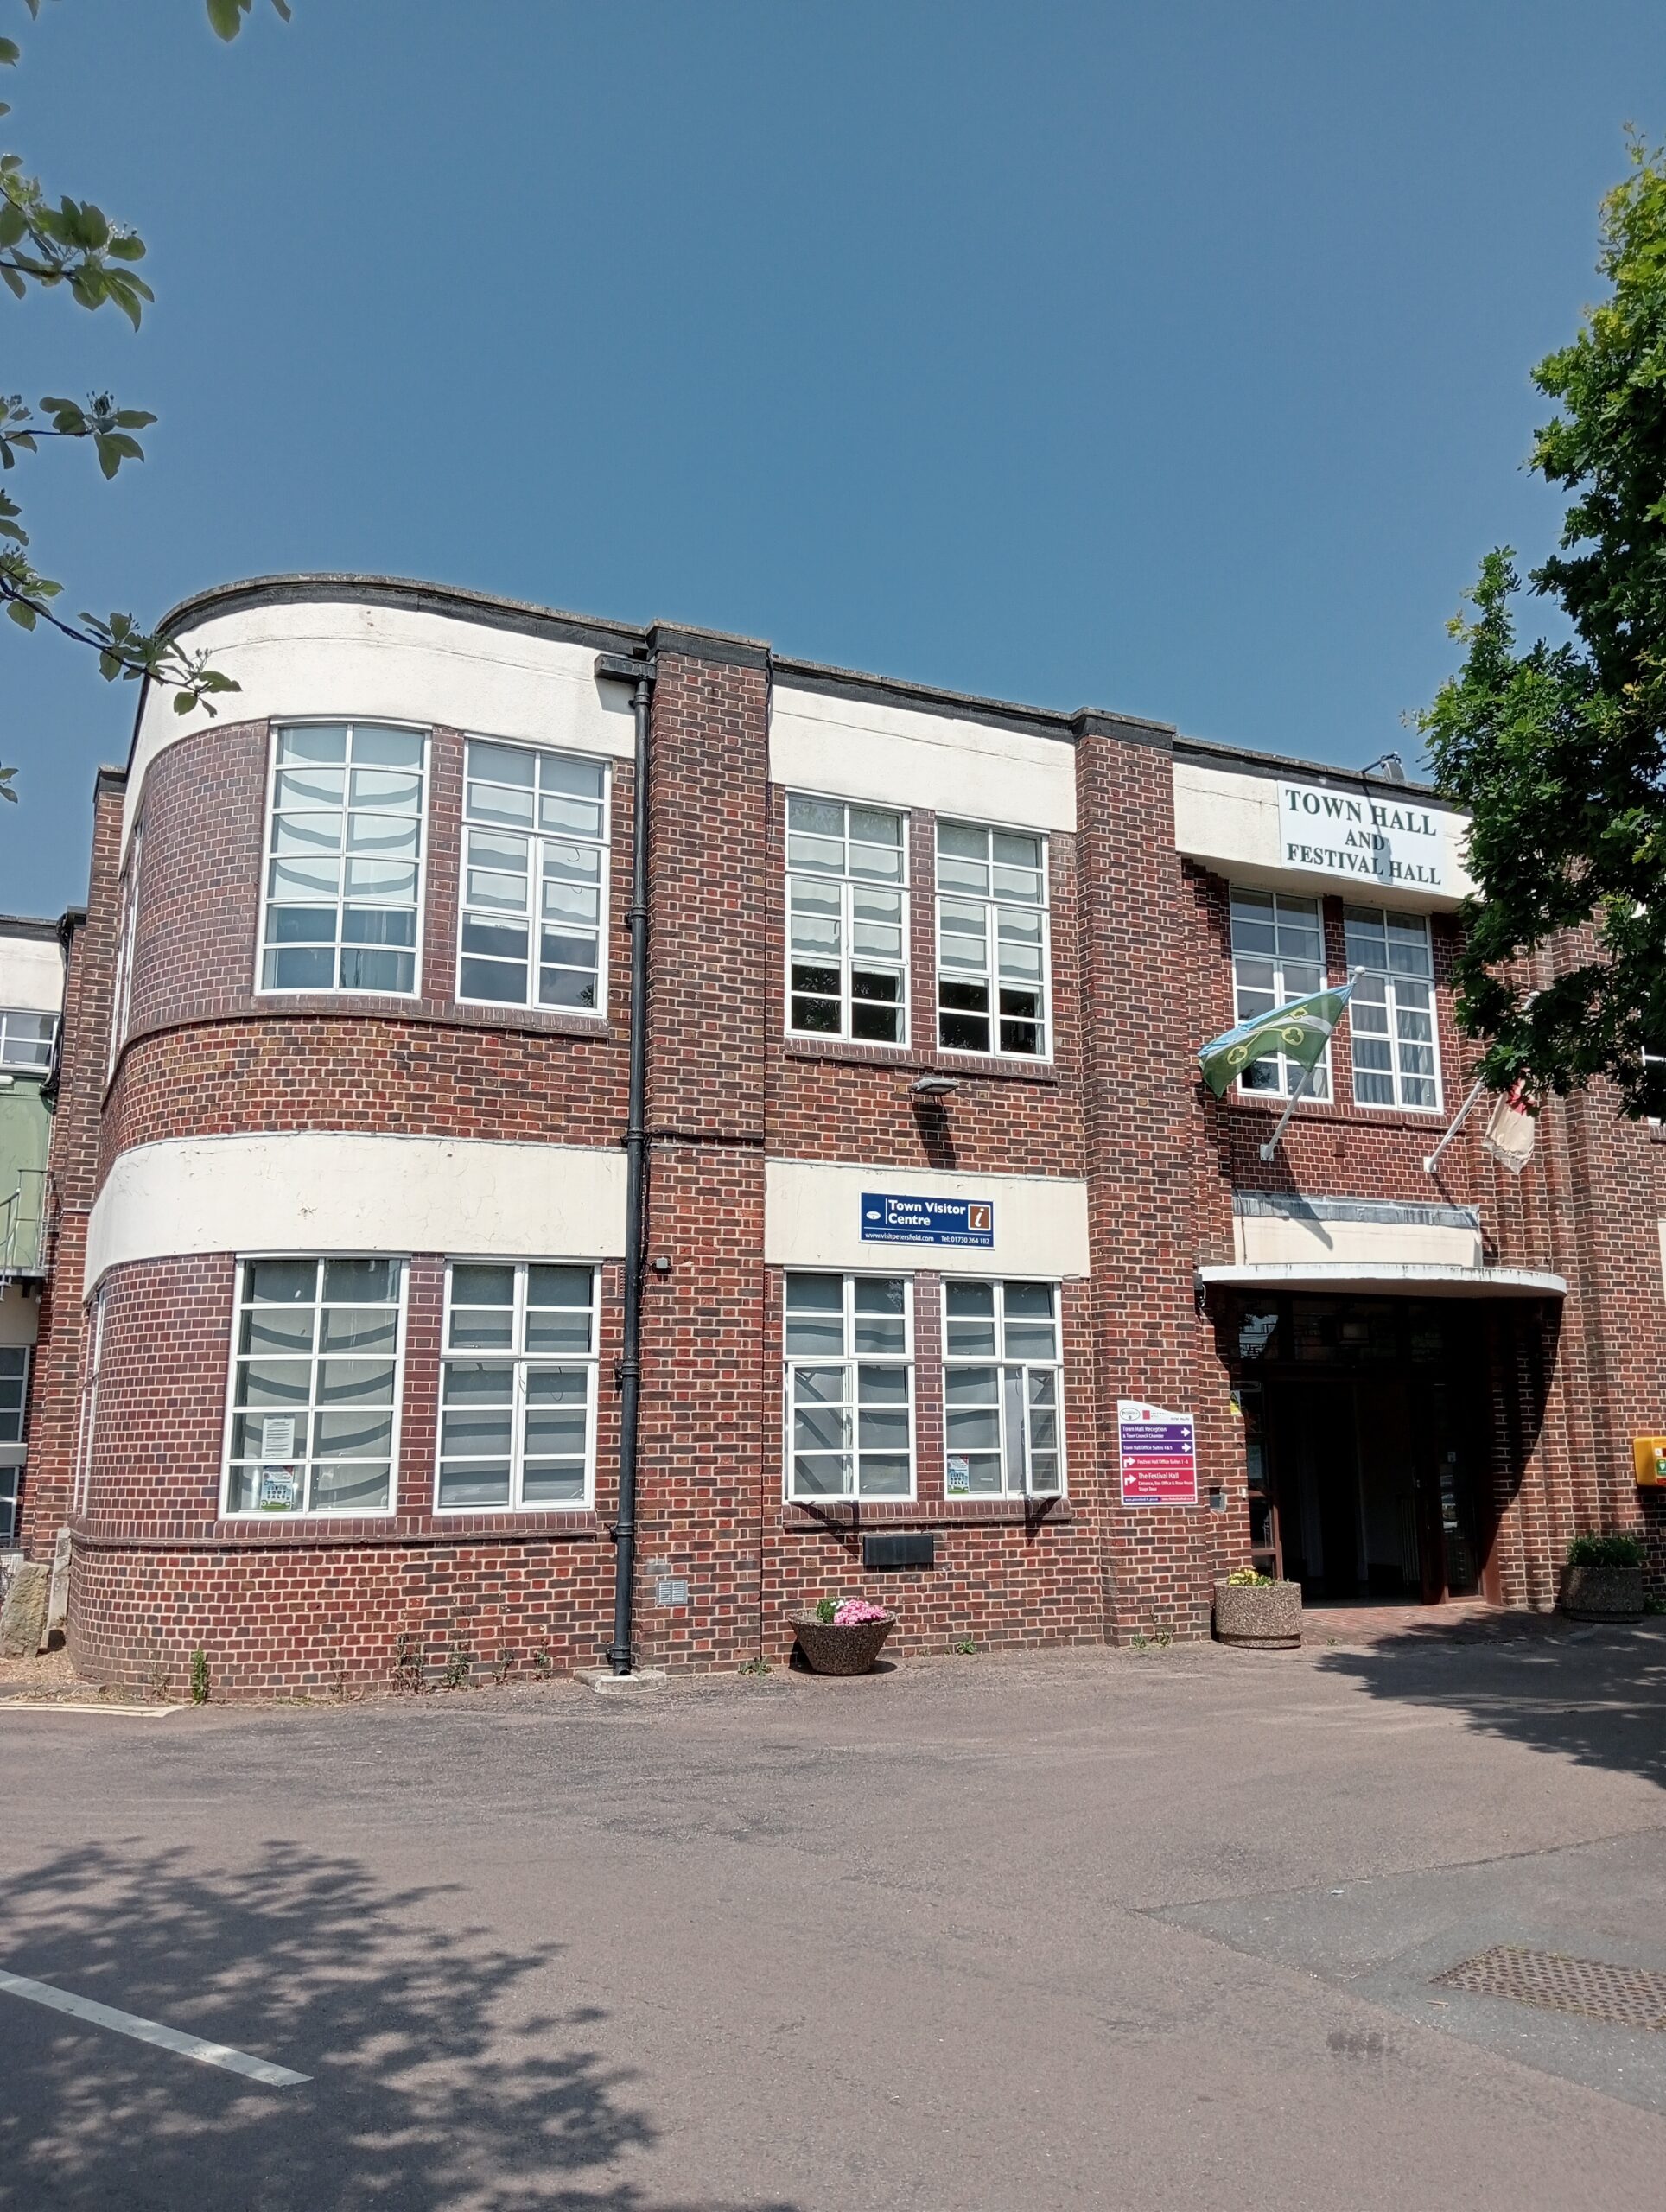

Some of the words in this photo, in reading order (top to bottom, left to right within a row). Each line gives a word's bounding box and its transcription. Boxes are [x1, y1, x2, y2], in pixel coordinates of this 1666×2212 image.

[1285, 789, 1362, 823] TOWN
[1371, 804, 1436, 836] HALL
[1345, 830, 1385, 851] AND
[1286, 842, 1383, 876] FESTIVAL
[1388, 860, 1441, 886] HALL
[888, 1199, 921, 1212] Town
[925, 1202, 966, 1215] Visitor
[888, 1213, 931, 1226] Centre
[865, 1232, 934, 1243] www.visitpetersfield.com
